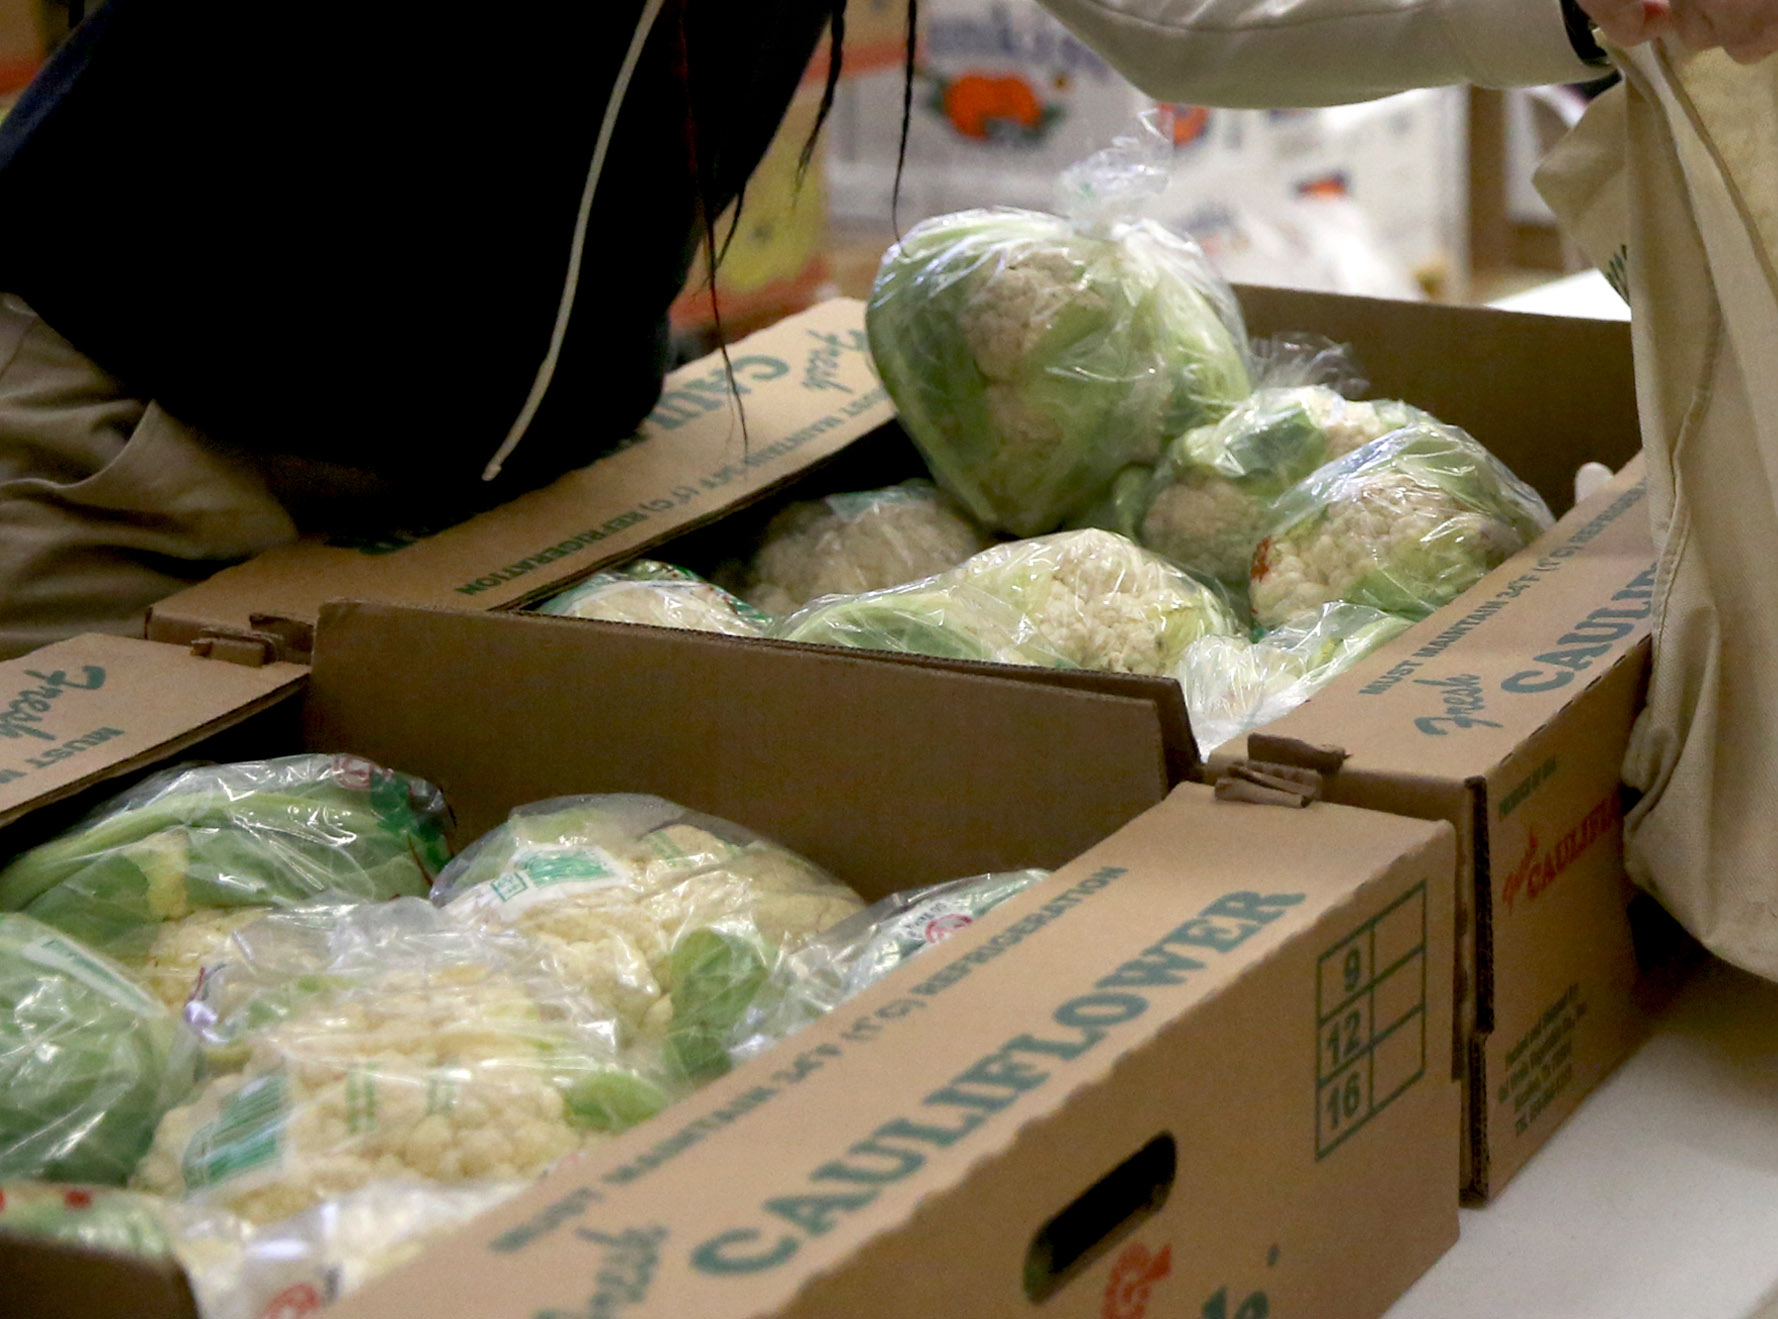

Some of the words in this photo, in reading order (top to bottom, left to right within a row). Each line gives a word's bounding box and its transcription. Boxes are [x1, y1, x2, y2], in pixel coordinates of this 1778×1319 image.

[454, 510, 648, 596] REFRIGERATION
[1358, 659, 1424, 695] MUST
[1411, 600, 1509, 658] MAINTAIN
[1412, 673, 1504, 736] Fresh
[24, 726, 126, 769] MUST
[910, 866, 1129, 996] REFRIGERATION
[1343, 947, 1361, 994] 9
[1326, 1009, 1362, 1069] 12
[690, 889, 1306, 1275] CAULIFLOWER
[1326, 1070, 1362, 1131] 16
